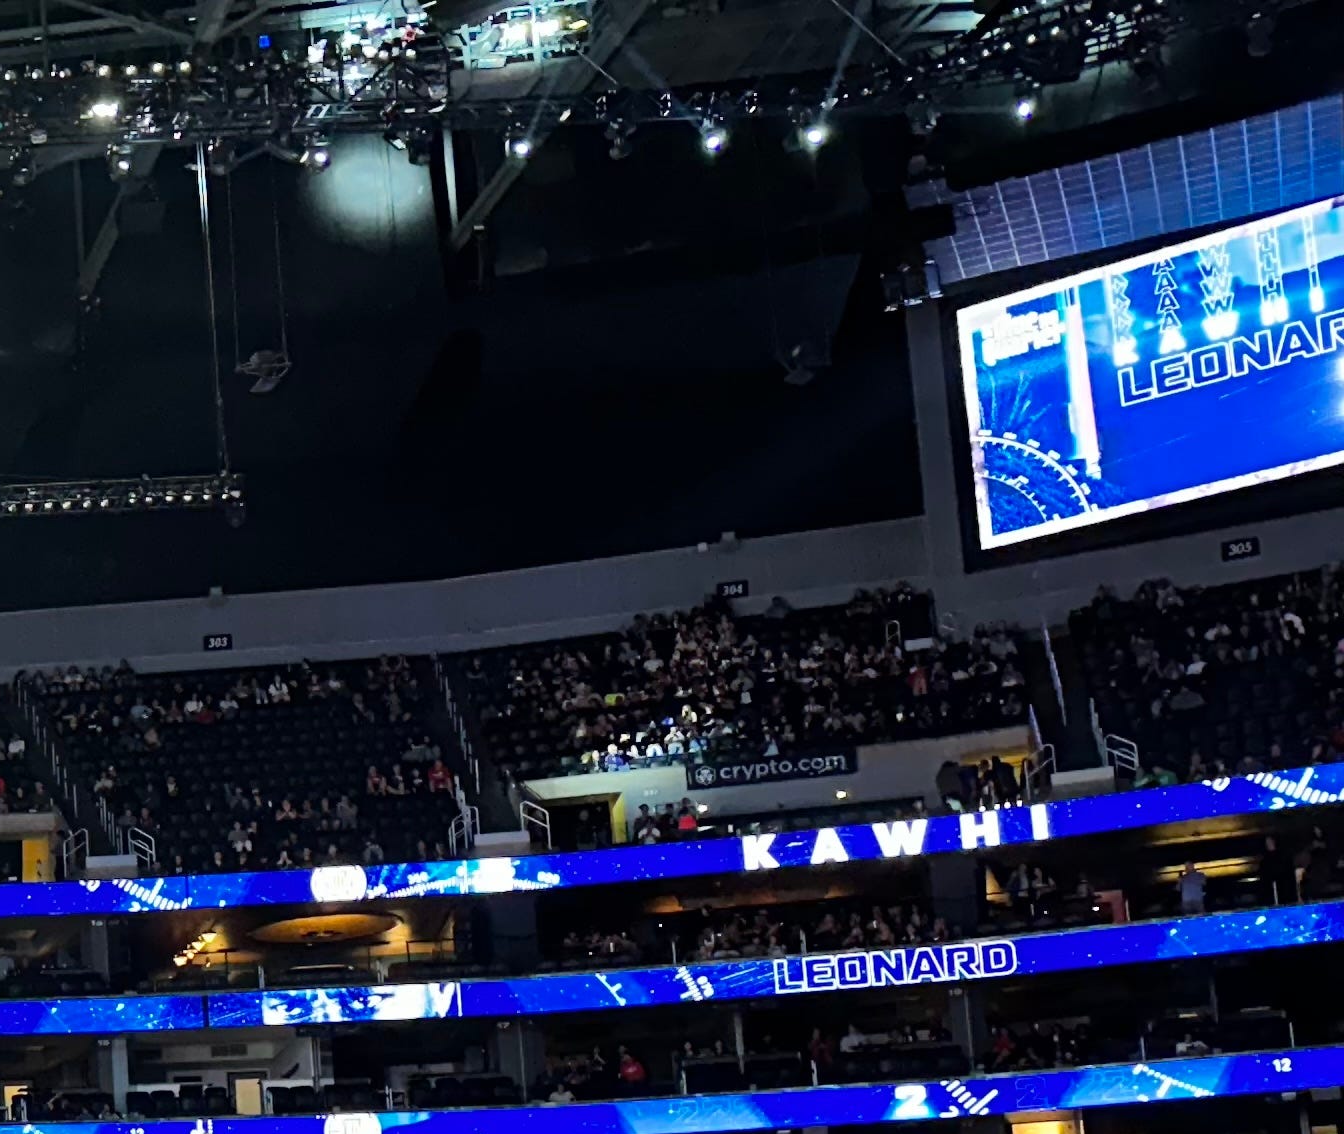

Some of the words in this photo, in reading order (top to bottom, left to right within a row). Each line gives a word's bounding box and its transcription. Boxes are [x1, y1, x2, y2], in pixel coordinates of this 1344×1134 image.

[1229, 542, 1252, 555] 305
[208, 637, 228, 649] 303
[719, 755, 845, 780] crypto.com
[741, 803, 1050, 870] KAWHI
[774, 940, 1017, 995] LEONARD
[1272, 1057, 1292, 1072] 12
[894, 1084, 932, 1118] 2
